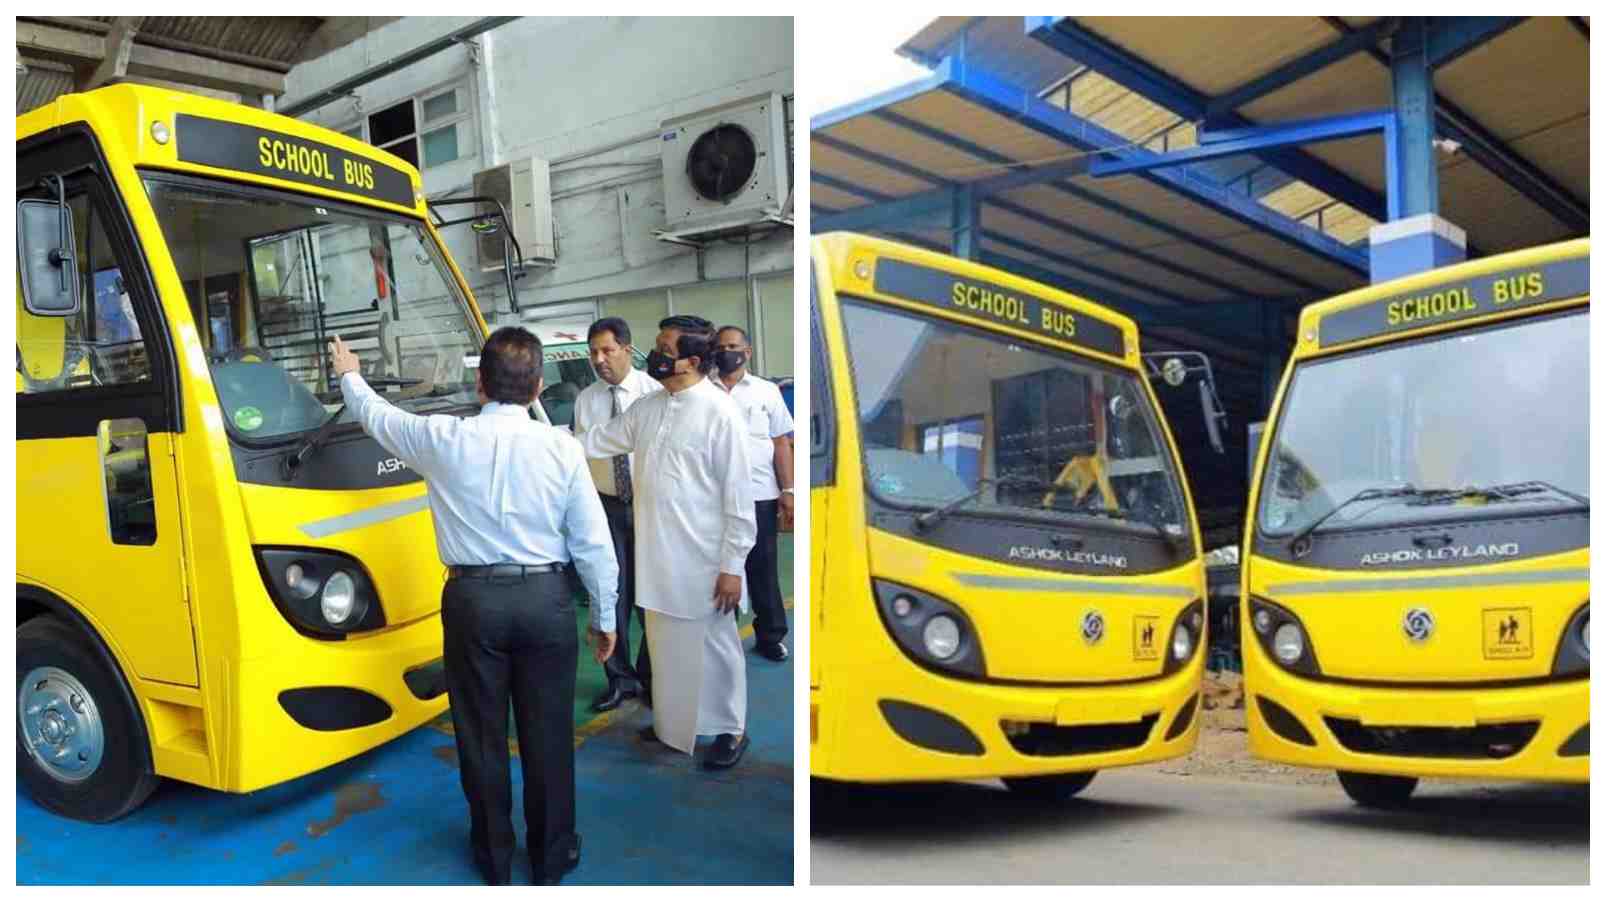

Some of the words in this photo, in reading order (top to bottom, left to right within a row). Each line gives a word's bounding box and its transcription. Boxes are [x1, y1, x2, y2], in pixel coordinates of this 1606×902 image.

[258, 136, 335, 181] SCHOOL
[343, 158, 375, 190] BUS
[952, 281, 1030, 325] SCHOOL
[1041, 307, 1075, 337] BUS
[1387, 287, 1477, 325] SCHOOL
[1493, 271, 1544, 303] BUS
[1009, 545, 1064, 561] ASHOK
[1360, 550, 1423, 565] ASHOK
[1427, 542, 1519, 560] LEYLAND
